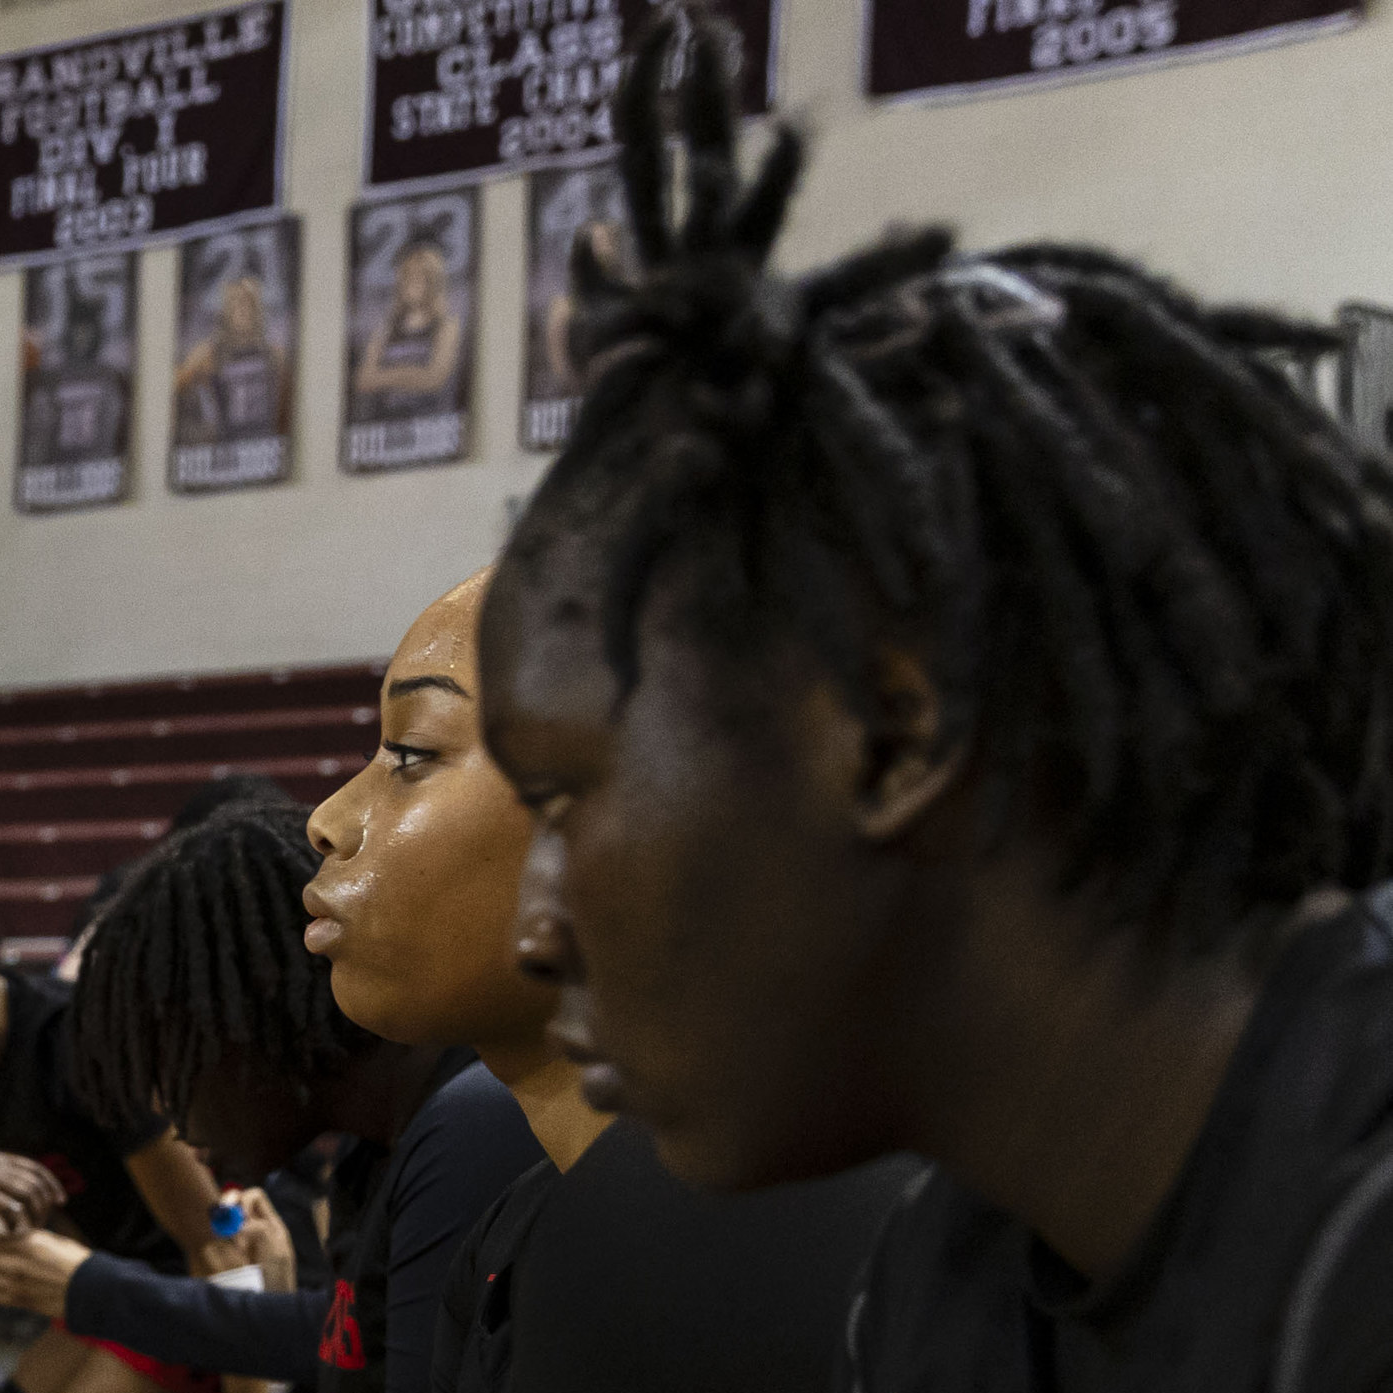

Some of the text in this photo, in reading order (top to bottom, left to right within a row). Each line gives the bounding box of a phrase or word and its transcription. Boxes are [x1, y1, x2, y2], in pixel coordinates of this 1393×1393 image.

[1029, 3, 1179, 69] 2005
[390, 88, 499, 142] STATE
[121, 141, 209, 196] FOUR
